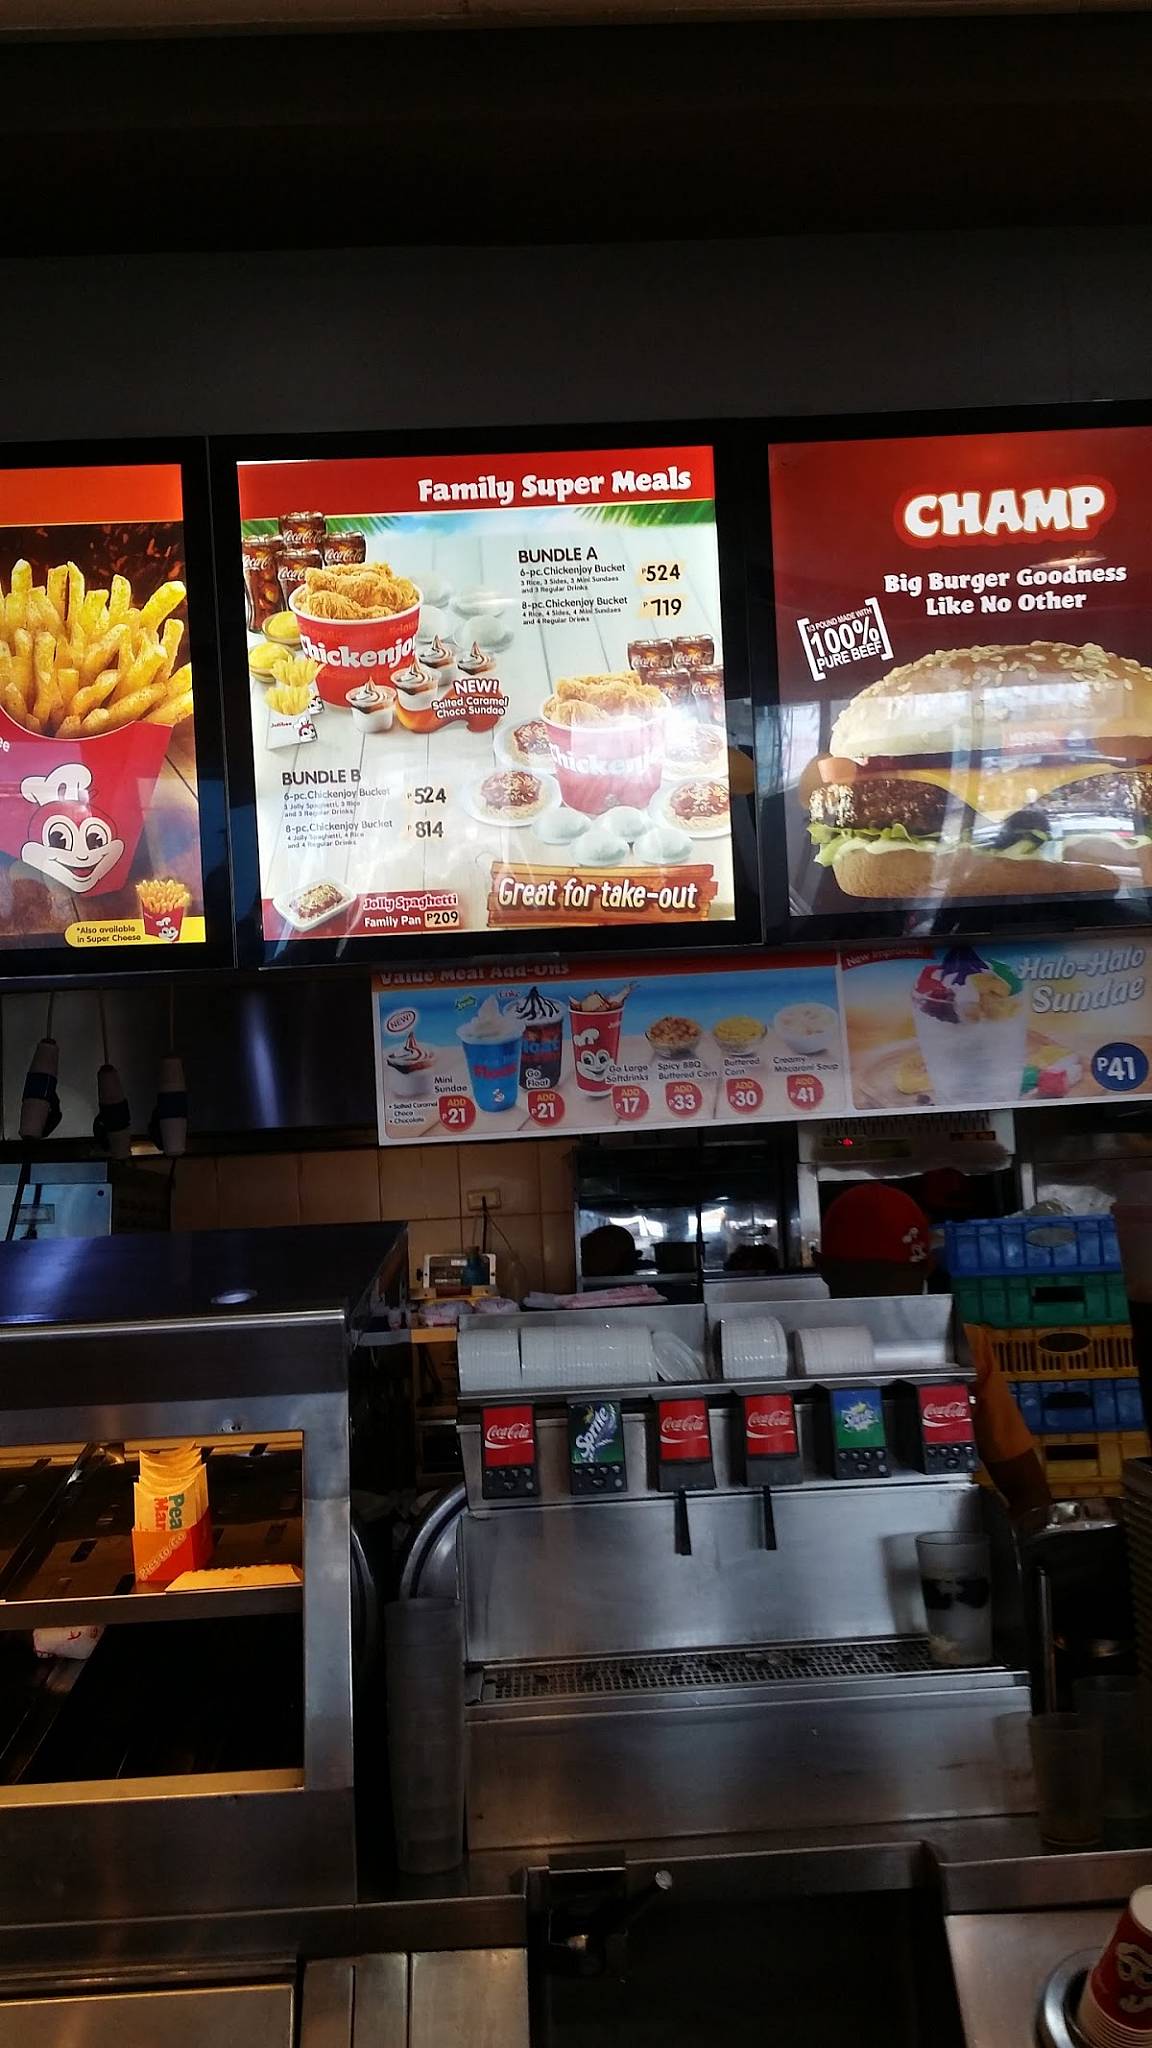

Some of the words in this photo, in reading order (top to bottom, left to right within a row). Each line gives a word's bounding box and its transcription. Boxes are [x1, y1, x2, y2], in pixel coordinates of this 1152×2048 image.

[417, 475, 514, 505] Family
[521, 474, 605, 503] Super
[611, 466, 692, 492] Meals
[904, 486, 1105, 537] CHAMP
[518, 547, 582, 563] BUNDLE
[586, 546, 599, 560] A
[594, 563, 626, 573] Bucket
[592, 575, 619, 583] Sundaes
[884, 573, 922, 597] Big
[927, 570, 1010, 593] Burger
[1016, 564, 1127, 586] Goodness
[540, 586, 565, 594] Regular
[596, 597, 628, 606] Bucket
[926, 597, 974, 616] Like
[980, 597, 1012, 613] No
[1018, 591, 1087, 610] Other
[542, 617, 567, 625] Regular
[815, 617, 838, 631] POUND
[837, 611, 856, 623] MADE
[855, 606, 873, 617] WITH
[810, 616, 880, 657] 100%
[816, 651, 851, 671] PURE
[851, 641, 883, 661] BEEF
[454, 680, 499, 695] NEW!
[432, 698, 463, 711] Salted
[465, 696, 509, 708] Caramel
[437, 707, 466, 719] Choco
[468, 705, 506, 716] Sundae
[282, 769, 346, 785] BUNDLE
[350, 768, 361, 782] B
[360, 787, 390, 797] Bucket
[362, 820, 393, 829] Bucket
[499, 877, 557, 907] Great
[563, 878, 596, 907] for
[600, 880, 698, 909] take-out
[364, 895, 395, 911] Jolly
[396, 892, 459, 910] Spaghetti
[364, 915, 398, 929] Family
[401, 914, 422, 927] Pan
[99, 925, 135, 933] available
[77, 935, 84, 943] in
[86, 935, 110, 944] Super
[112, 934, 141, 942] Cheese
[1017, 946, 1146, 980] Halo-Halo
[380, 971, 434, 985] Value
[440, 967, 485, 981] Meal
[1032, 977, 1146, 1014] Sundae
[389, 1012, 412, 1029] NEW!
[658, 1062, 679, 1071] Spicy
[682, 1061, 701, 1069] BBQ
[724, 1057, 760, 1066] Buttered
[609, 1064, 621, 1073] Go
[624, 1063, 649, 1074] Large
[725, 1068, 745, 1076] Corn
[817, 1063, 839, 1072] Soup
[527, 1069, 540, 1078] Go
[606, 1072, 649, 1082] Softdrinks
[659, 1071, 695, 1080] Buttered
[697, 1070, 718, 1078] Corn
[434, 1076, 453, 1084] Mini
[527, 1078, 549, 1088] Float
[795, 1077, 814, 1086] ADD
[434, 1084, 467, 1093] Sundae
[674, 1085, 693, 1093] ADD
[735, 1081, 754, 1090] ADD
[621, 1088, 640, 1096] ADD
[447, 1098, 466, 1106] ADD
[537, 1094, 556, 1102] ADD
[575, 1406, 607, 1458] Sprite
[169, 1493, 185, 1530] Pea
